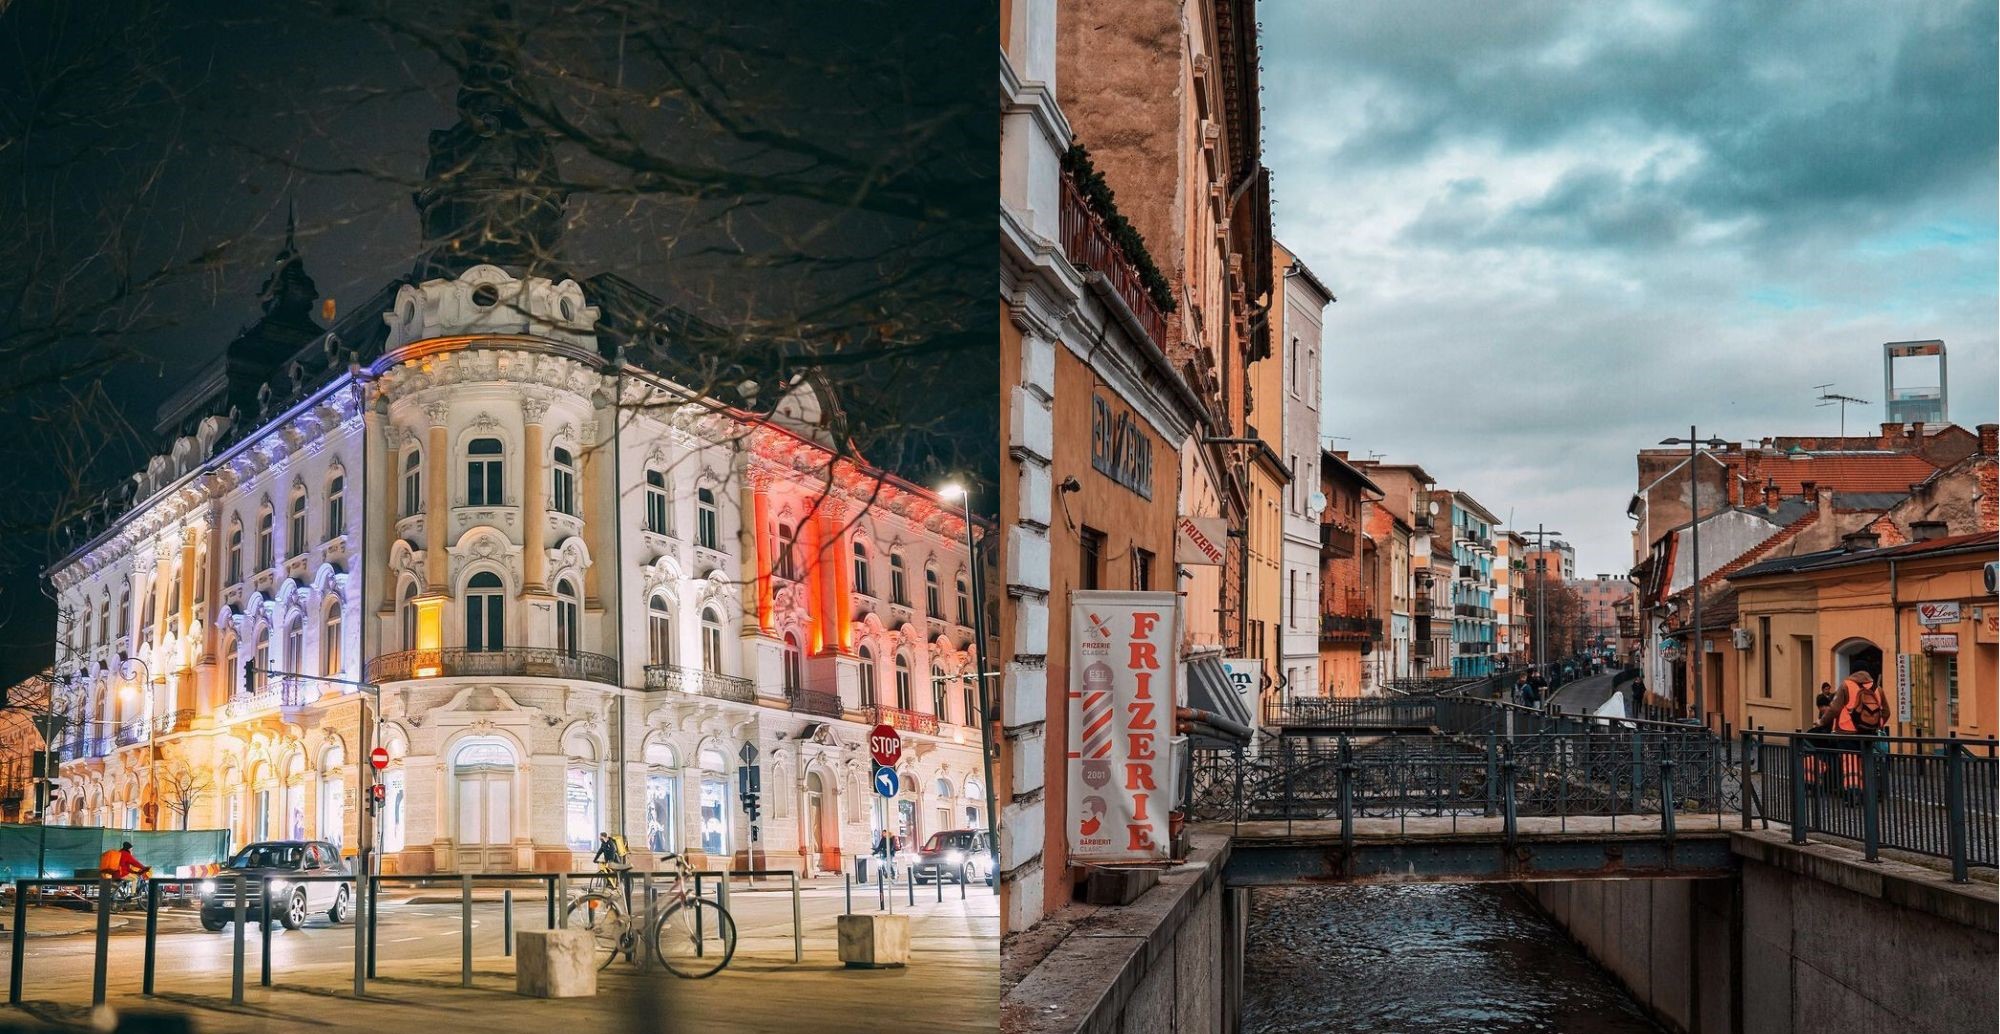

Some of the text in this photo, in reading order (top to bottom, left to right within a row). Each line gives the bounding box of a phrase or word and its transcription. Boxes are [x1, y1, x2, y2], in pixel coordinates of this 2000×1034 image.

[1179, 518, 1222, 564] FRIZERIE
[872, 736, 900, 755] STOP
[1124, 612, 1161, 851] FRIZERIE
[1087, 771, 1106, 779] 2001
